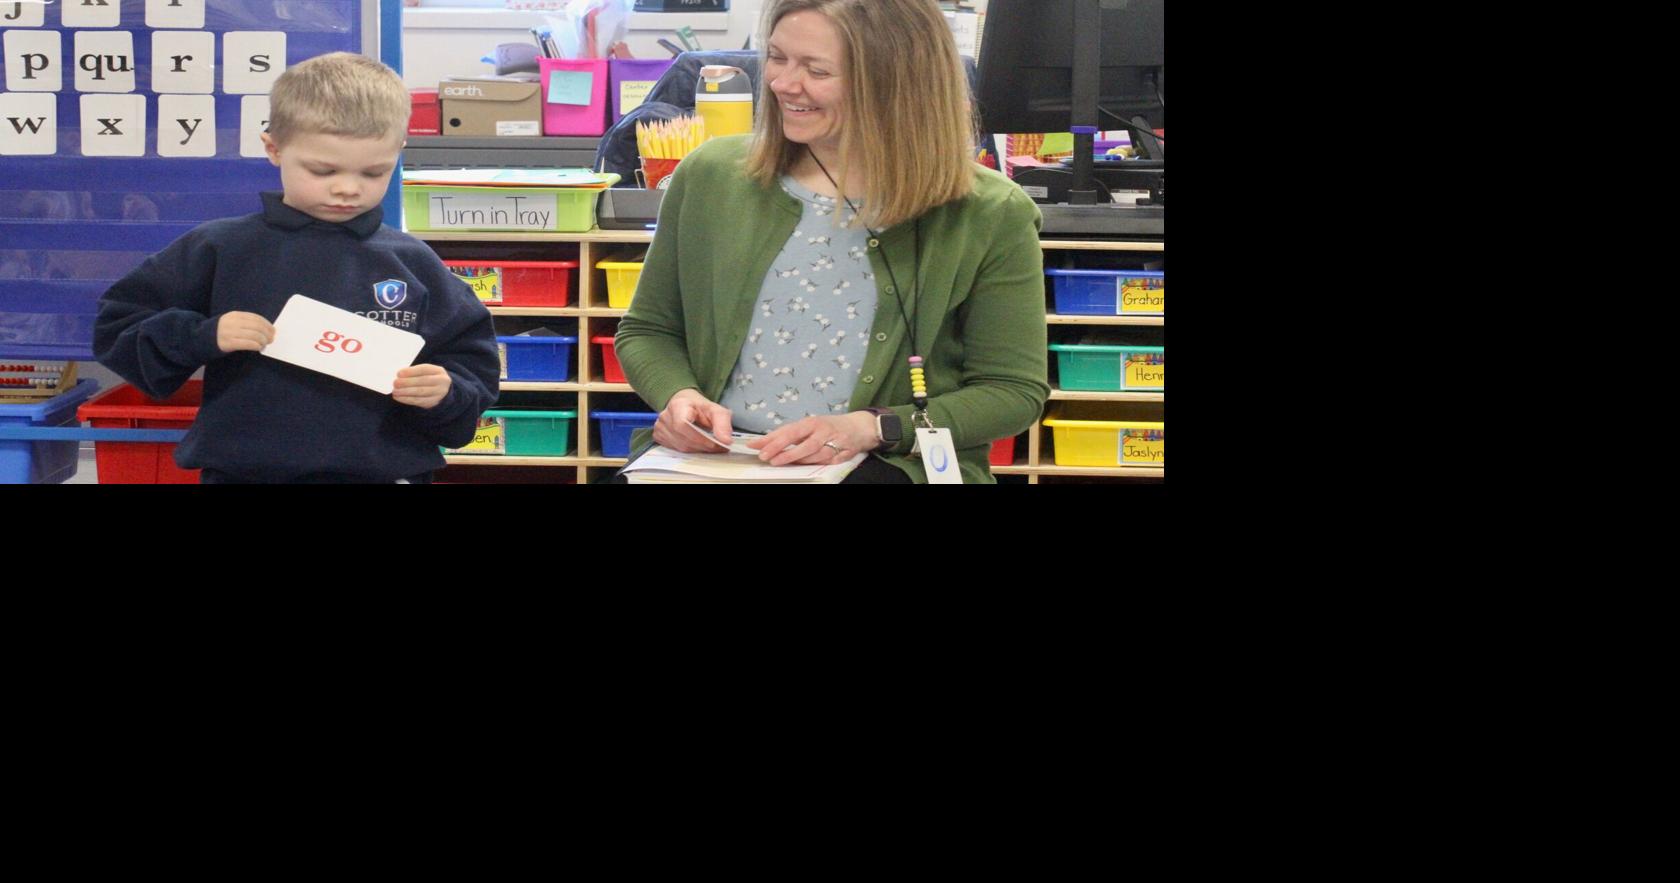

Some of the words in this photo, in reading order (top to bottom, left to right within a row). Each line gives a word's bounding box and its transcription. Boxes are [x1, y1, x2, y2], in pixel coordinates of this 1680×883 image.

[20, 52, 50, 80] p
[169, 54, 193, 73] r
[248, 54, 271, 73] s
[6, 116, 46, 135] w
[97, 117, 124, 136] x
[175, 117, 202, 145] y
[432, 196, 485, 225] Turn
[490, 206, 508, 225] in
[505, 196, 550, 229] Tray
[382, 283, 399, 304] C
[314, 331, 363, 353] go
